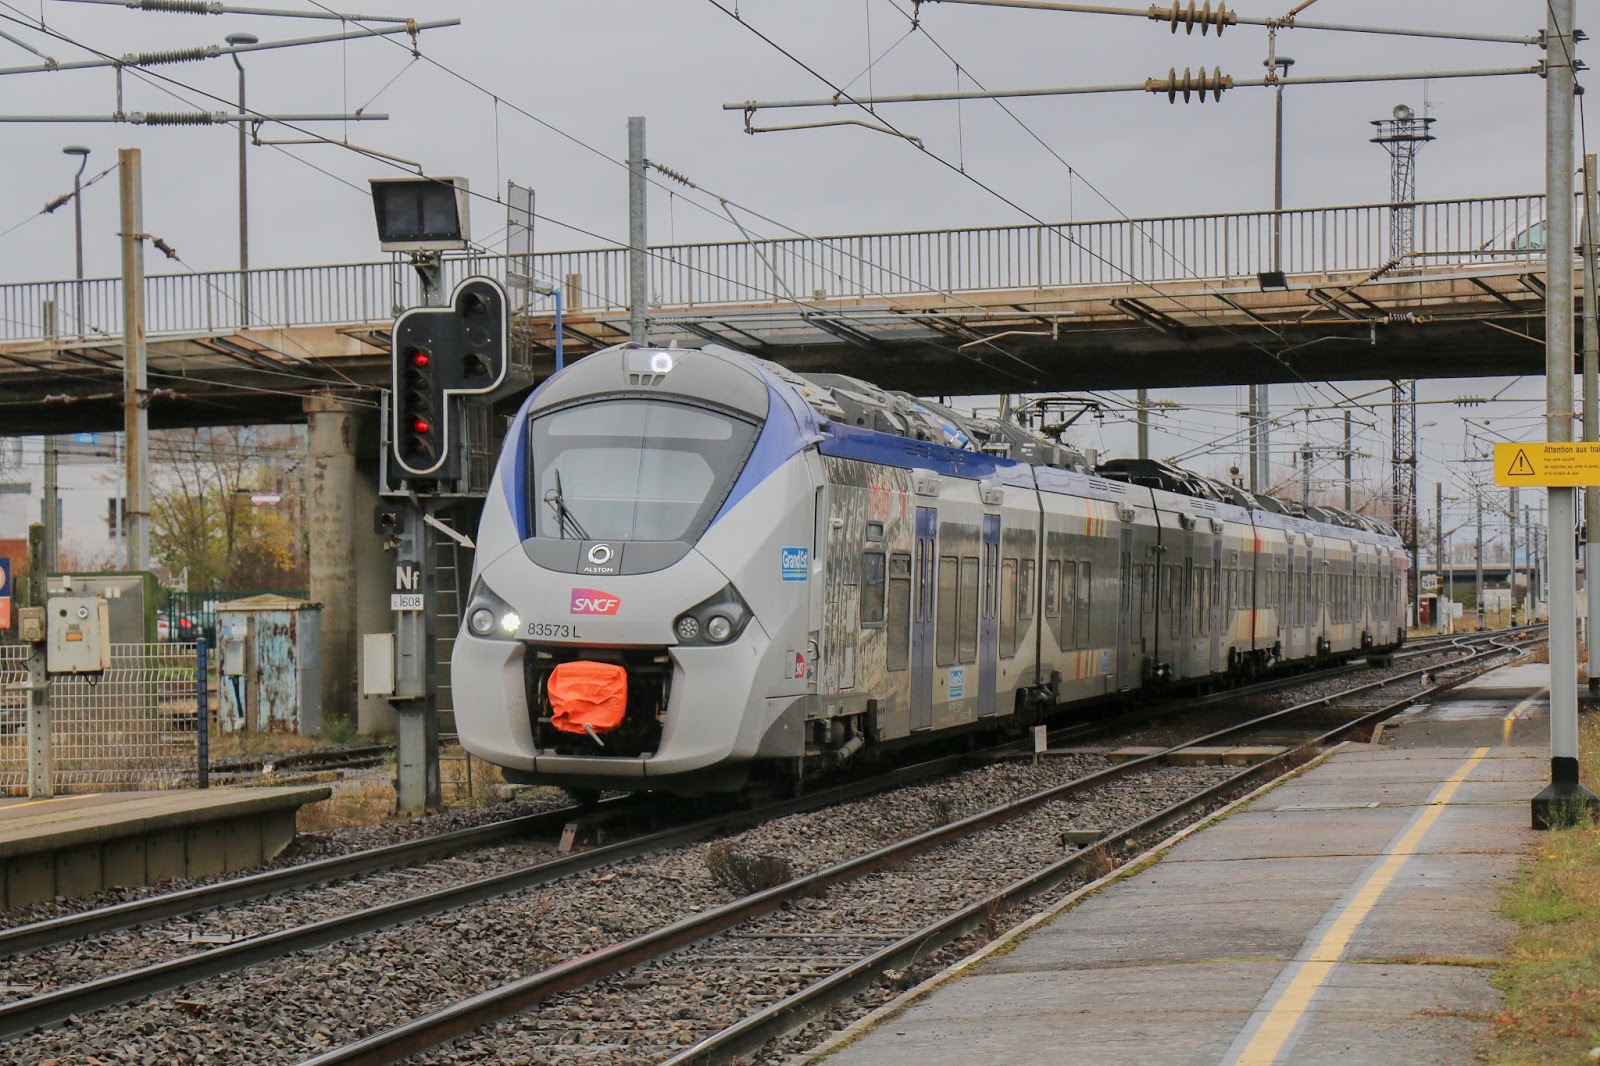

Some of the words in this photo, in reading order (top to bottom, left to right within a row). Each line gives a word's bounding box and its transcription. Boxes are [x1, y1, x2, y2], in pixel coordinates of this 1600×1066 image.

[396, 565, 420, 590] Nf
[572, 598, 618, 612] SNCF
[527, 622, 570, 638] 83573
[573, 625, 581, 638] L
